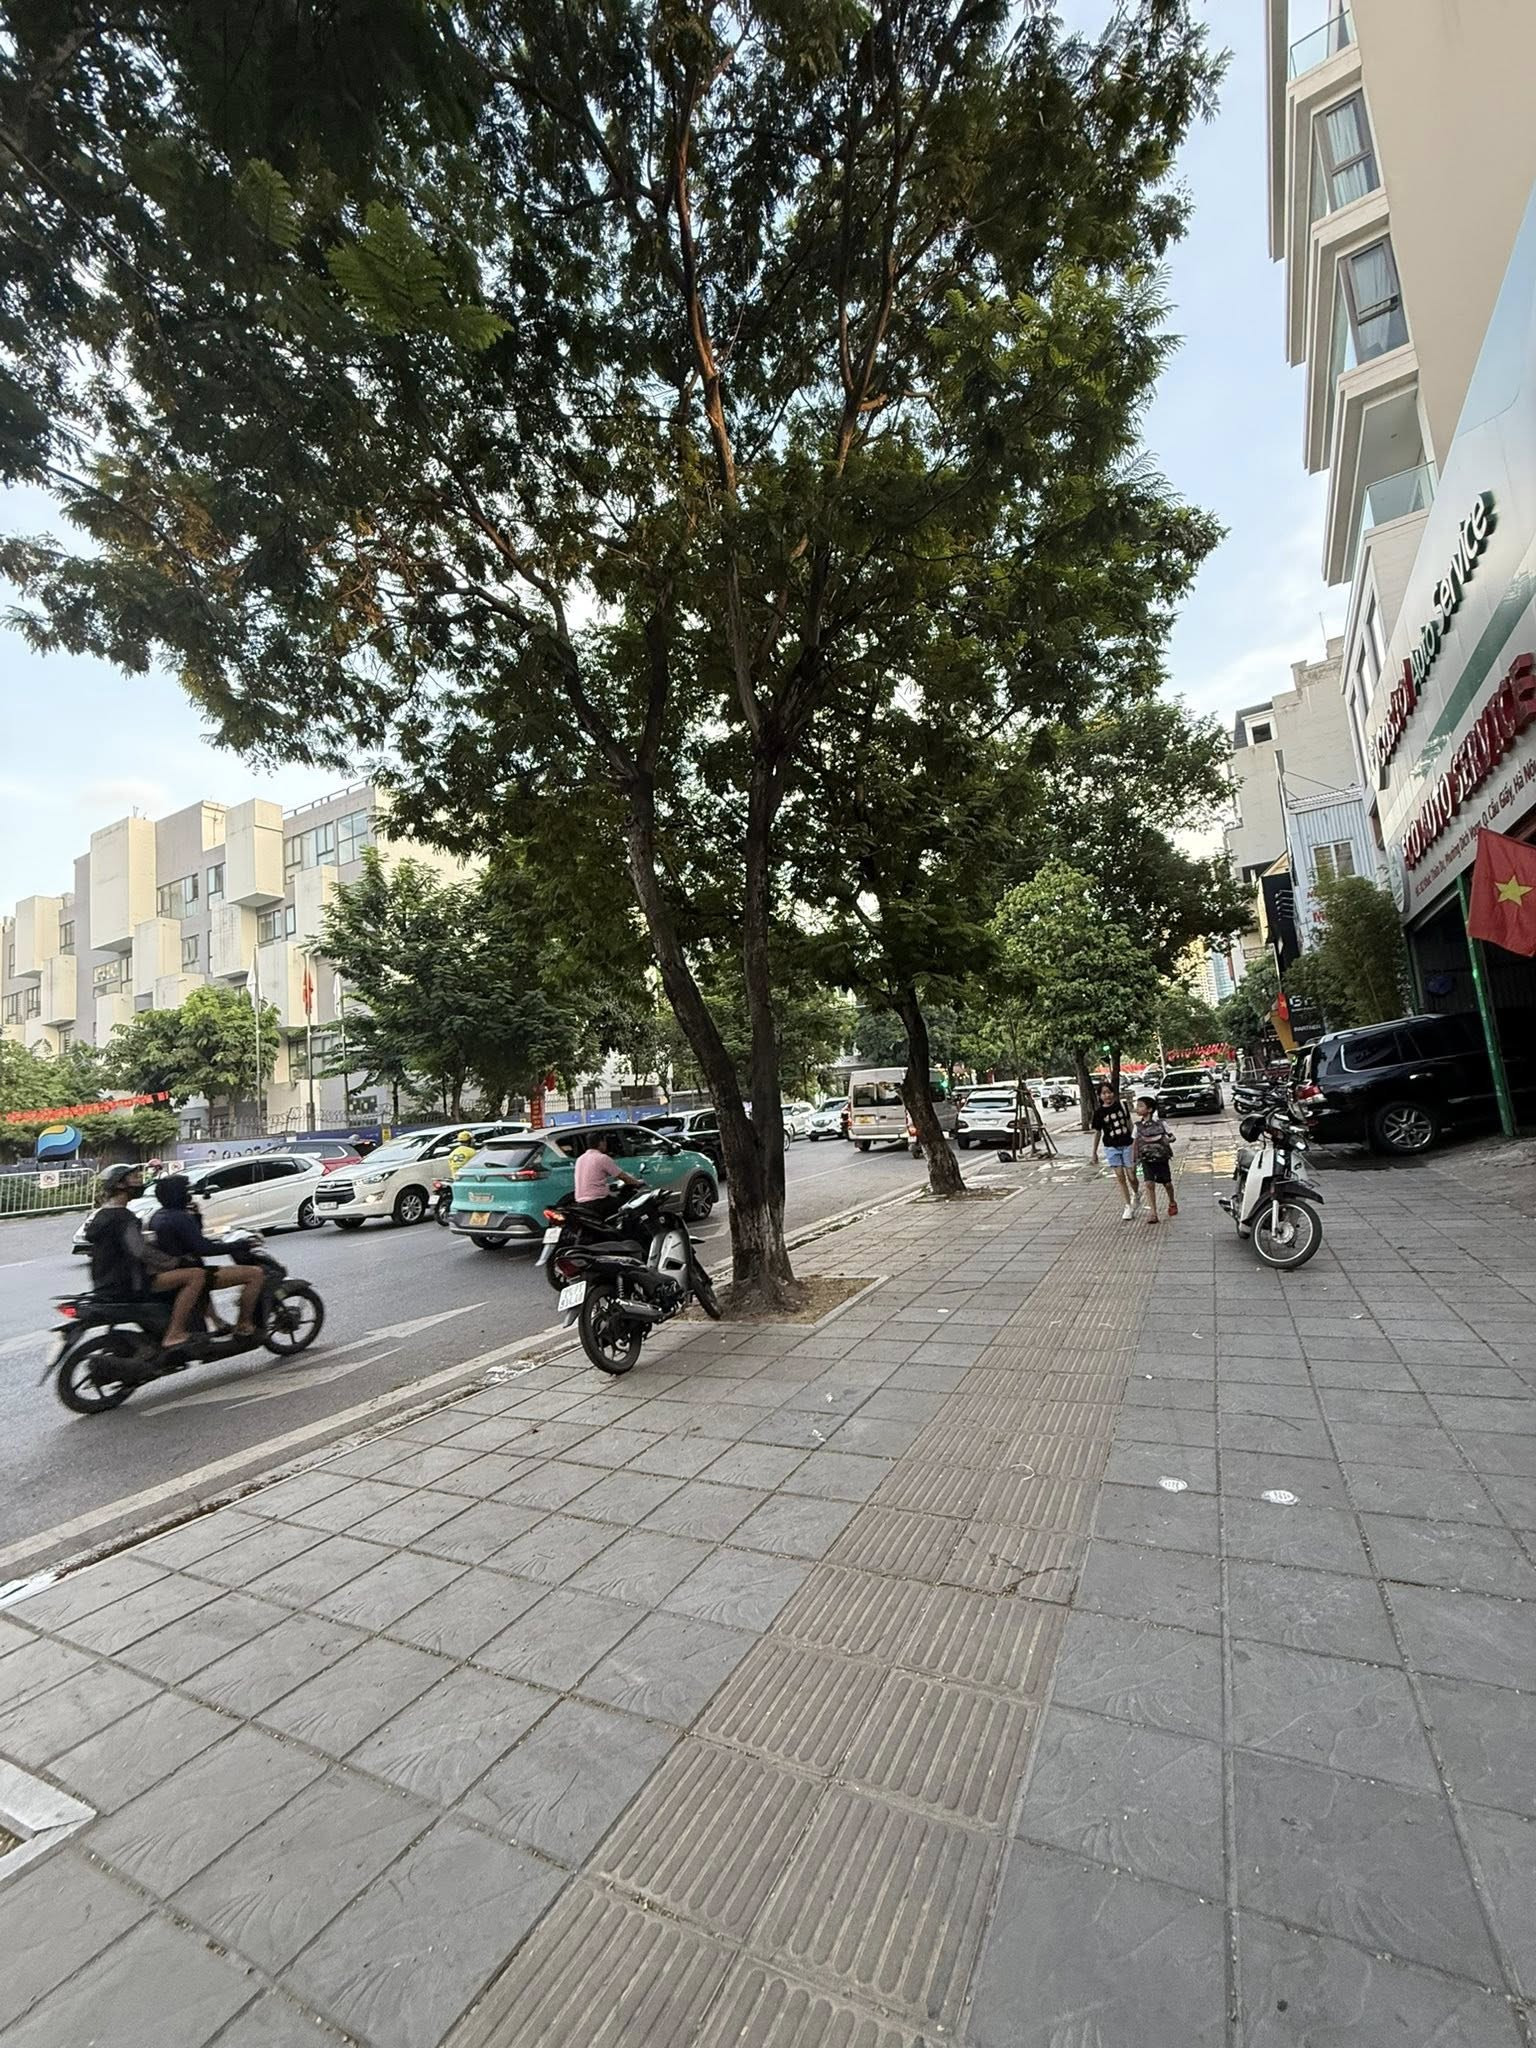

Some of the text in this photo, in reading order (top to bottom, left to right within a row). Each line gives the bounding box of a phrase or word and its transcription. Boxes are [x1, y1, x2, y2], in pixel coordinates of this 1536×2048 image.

[1409, 621, 1439, 692] Auto
[1432, 490, 1495, 637] Service
[1419, 771, 1454, 852] AUTO
[1451, 652, 1536, 804] SERVICE
[1488, 798, 1500, 820] Cầu
[1513, 770, 1524, 794] Hà
